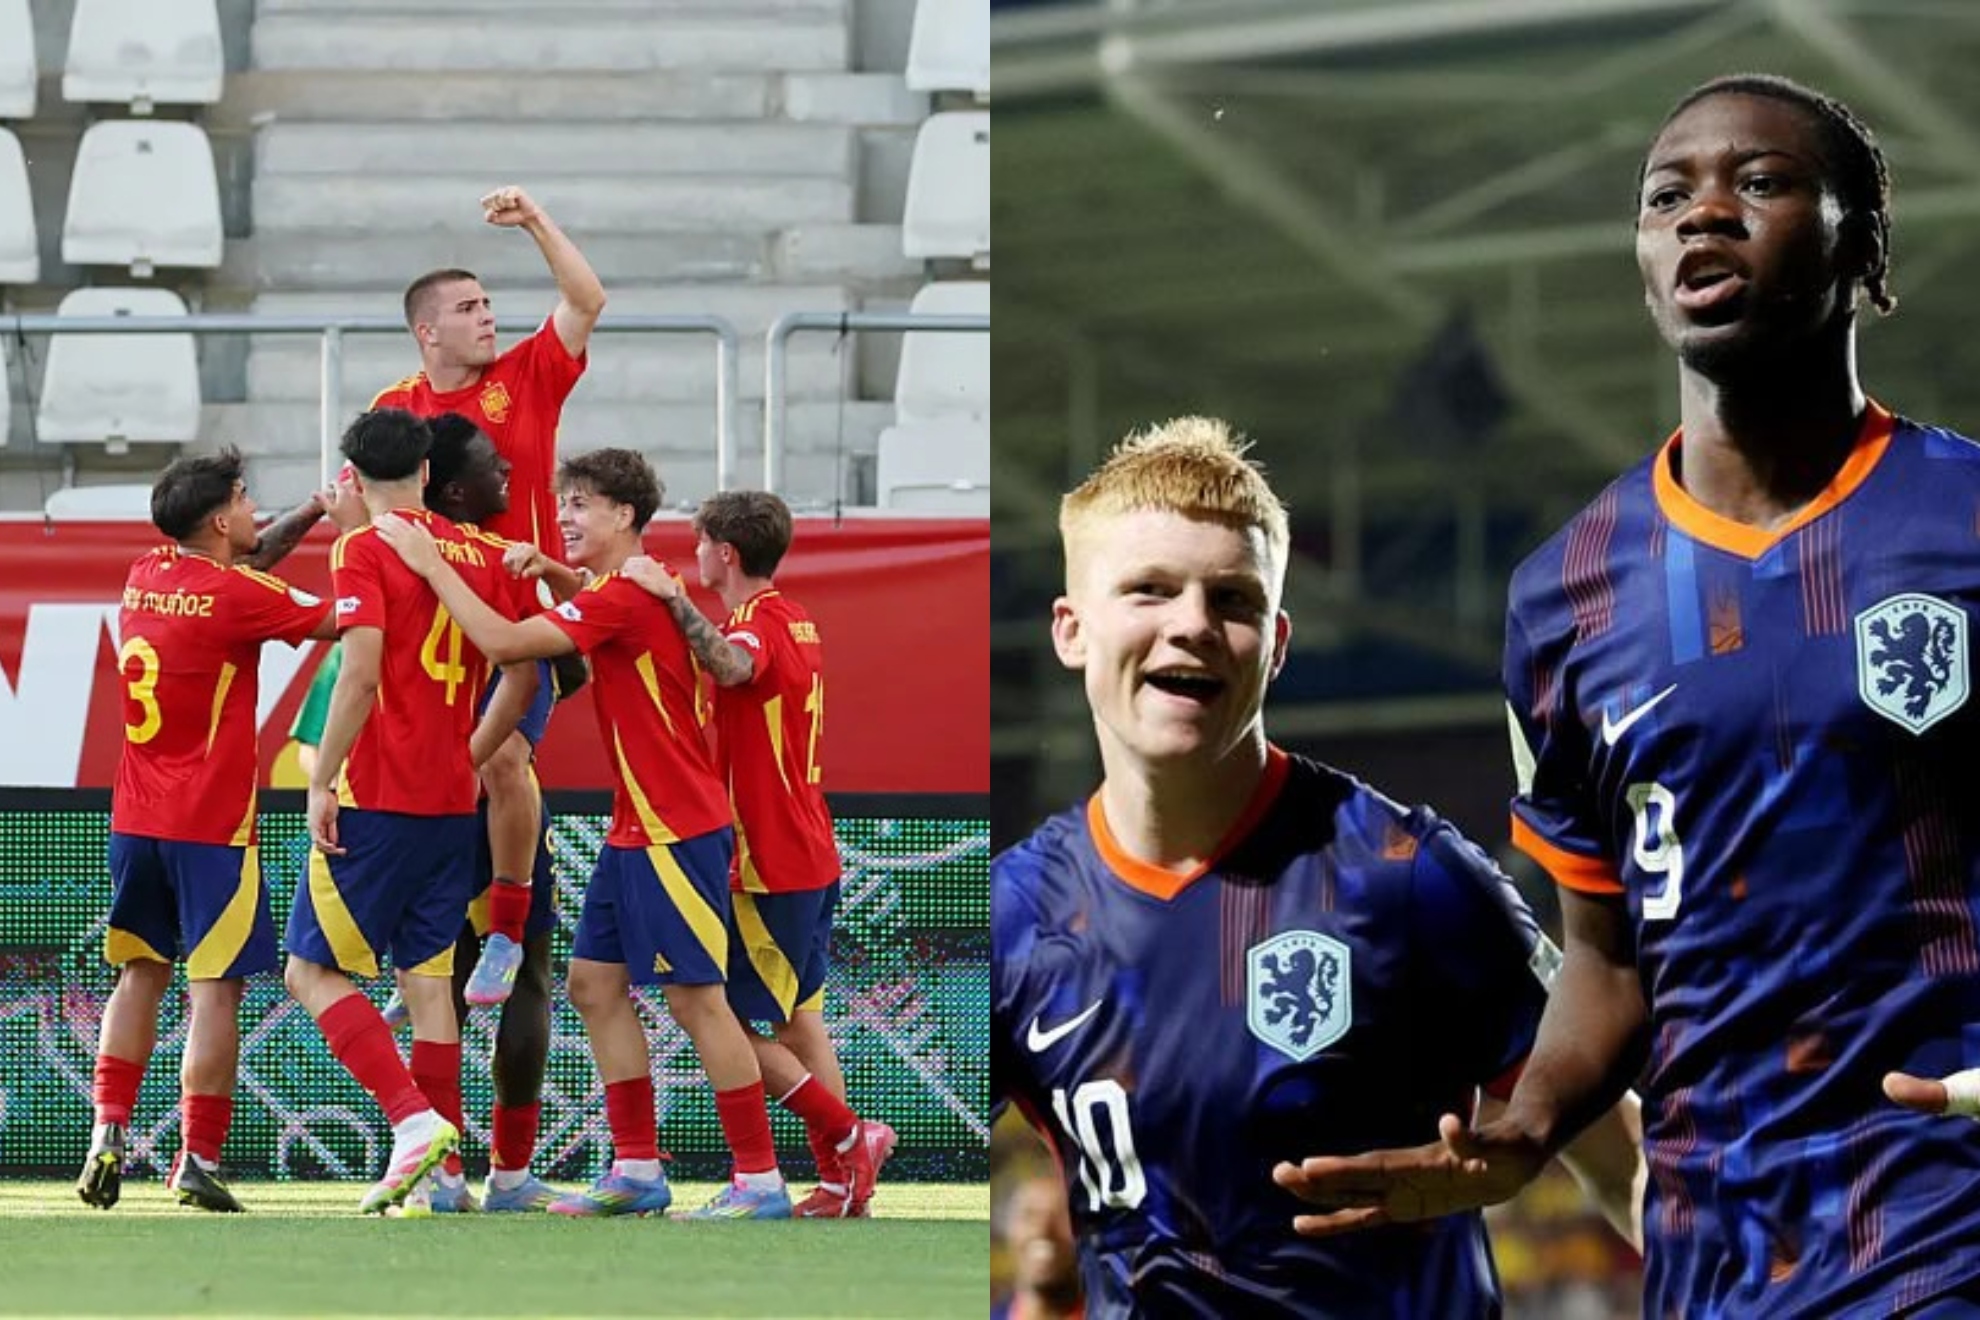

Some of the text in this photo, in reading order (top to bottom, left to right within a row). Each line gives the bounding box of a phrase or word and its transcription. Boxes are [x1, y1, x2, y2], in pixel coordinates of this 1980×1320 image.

[143, 588, 215, 617] MUÑOZ
[421, 600, 466, 706] 4
[118, 636, 162, 744] 3
[1626, 781, 1684, 920] 9
[1052, 1079, 1147, 1212] 10
